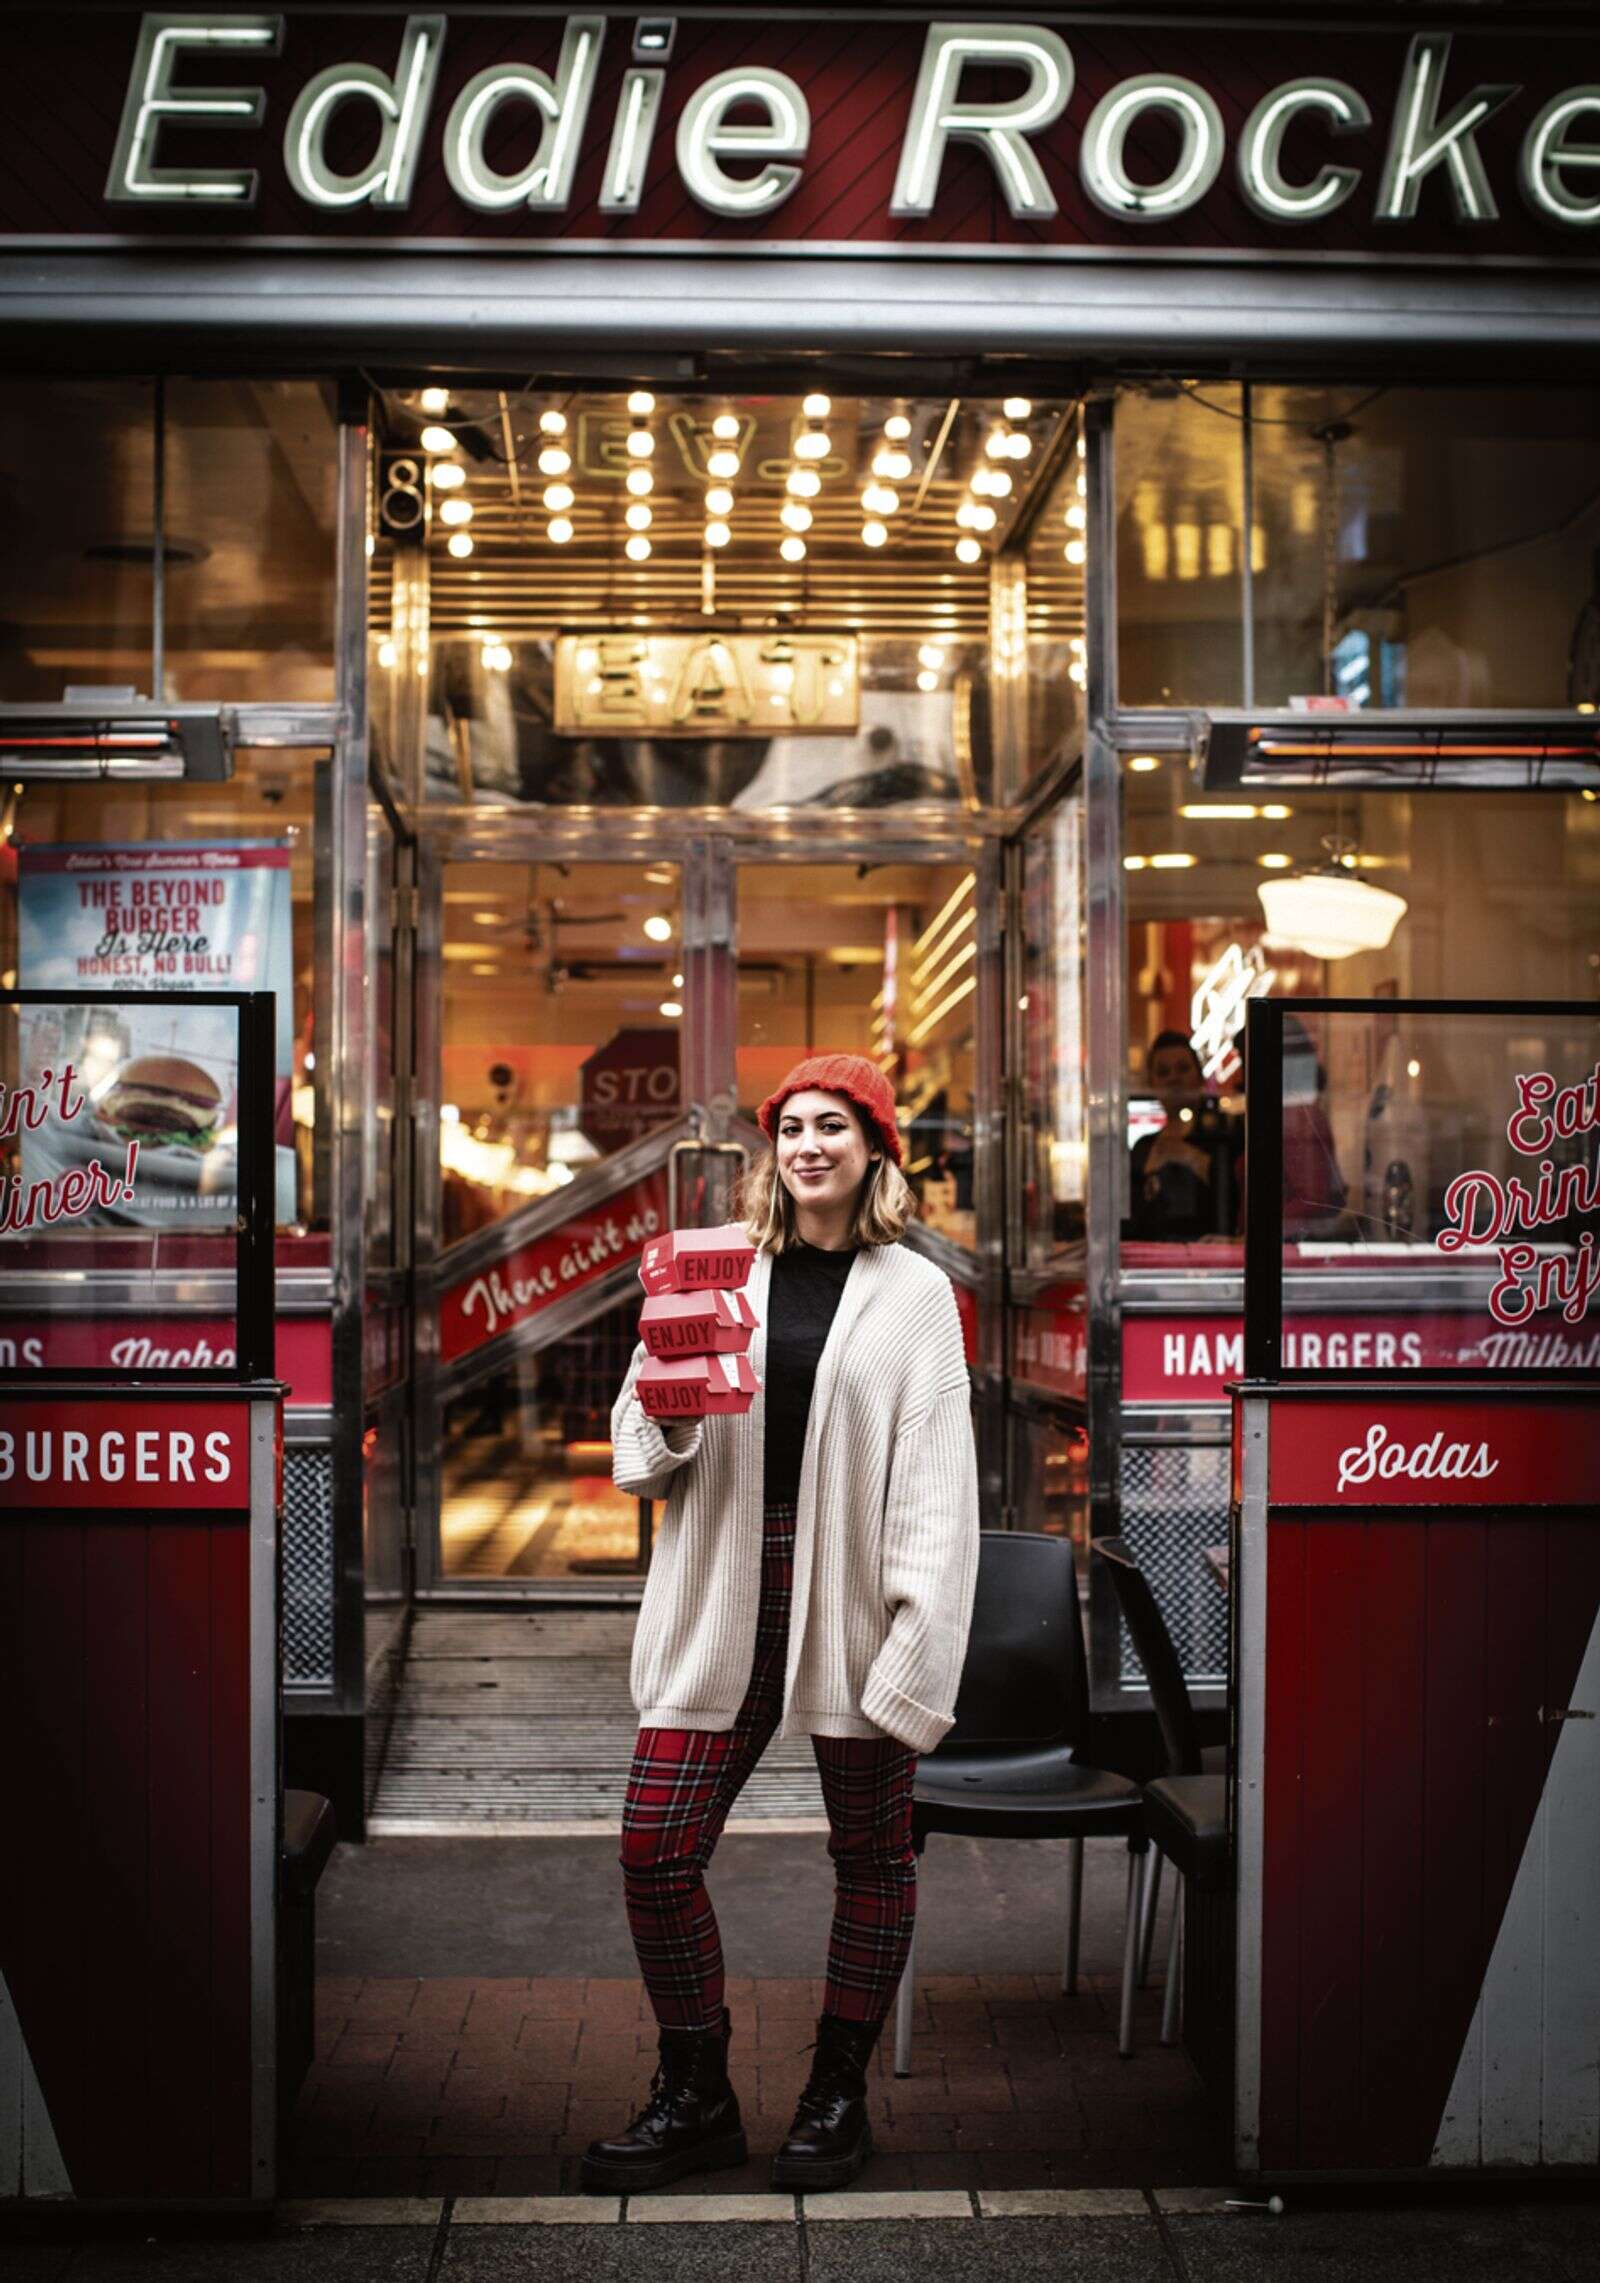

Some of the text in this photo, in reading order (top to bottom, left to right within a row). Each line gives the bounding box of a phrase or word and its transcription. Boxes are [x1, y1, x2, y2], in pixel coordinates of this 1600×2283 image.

[104, 12, 1600, 227] Eddie Rocke
[382, 458, 424, 530] 8
[572, 635, 848, 727] EAT
[77, 879, 226, 908] THE BEYOND
[95, 930, 209, 959] Is Here
[105, 907, 201, 935] BURGER
[76, 953, 232, 976] HONEST, NO BULL!
[592, 1066, 678, 1105] STO
[0, 1139, 140, 1234] iner!
[1437, 1160, 1600, 1252] Drin
[461, 1264, 557, 1333] There
[626, 1208, 659, 1242] no
[684, 1256, 746, 1281] ENJOY
[1489, 1231, 1600, 1326] Enj
[647, 1321, 710, 1349] ENJOY
[1163, 1332, 1422, 1376] HAMURGERS
[644, 1385, 701, 1410] ENJOY
[0, 1430, 232, 1483] BURGERS
[1337, 1424, 1499, 1493] Sodas
